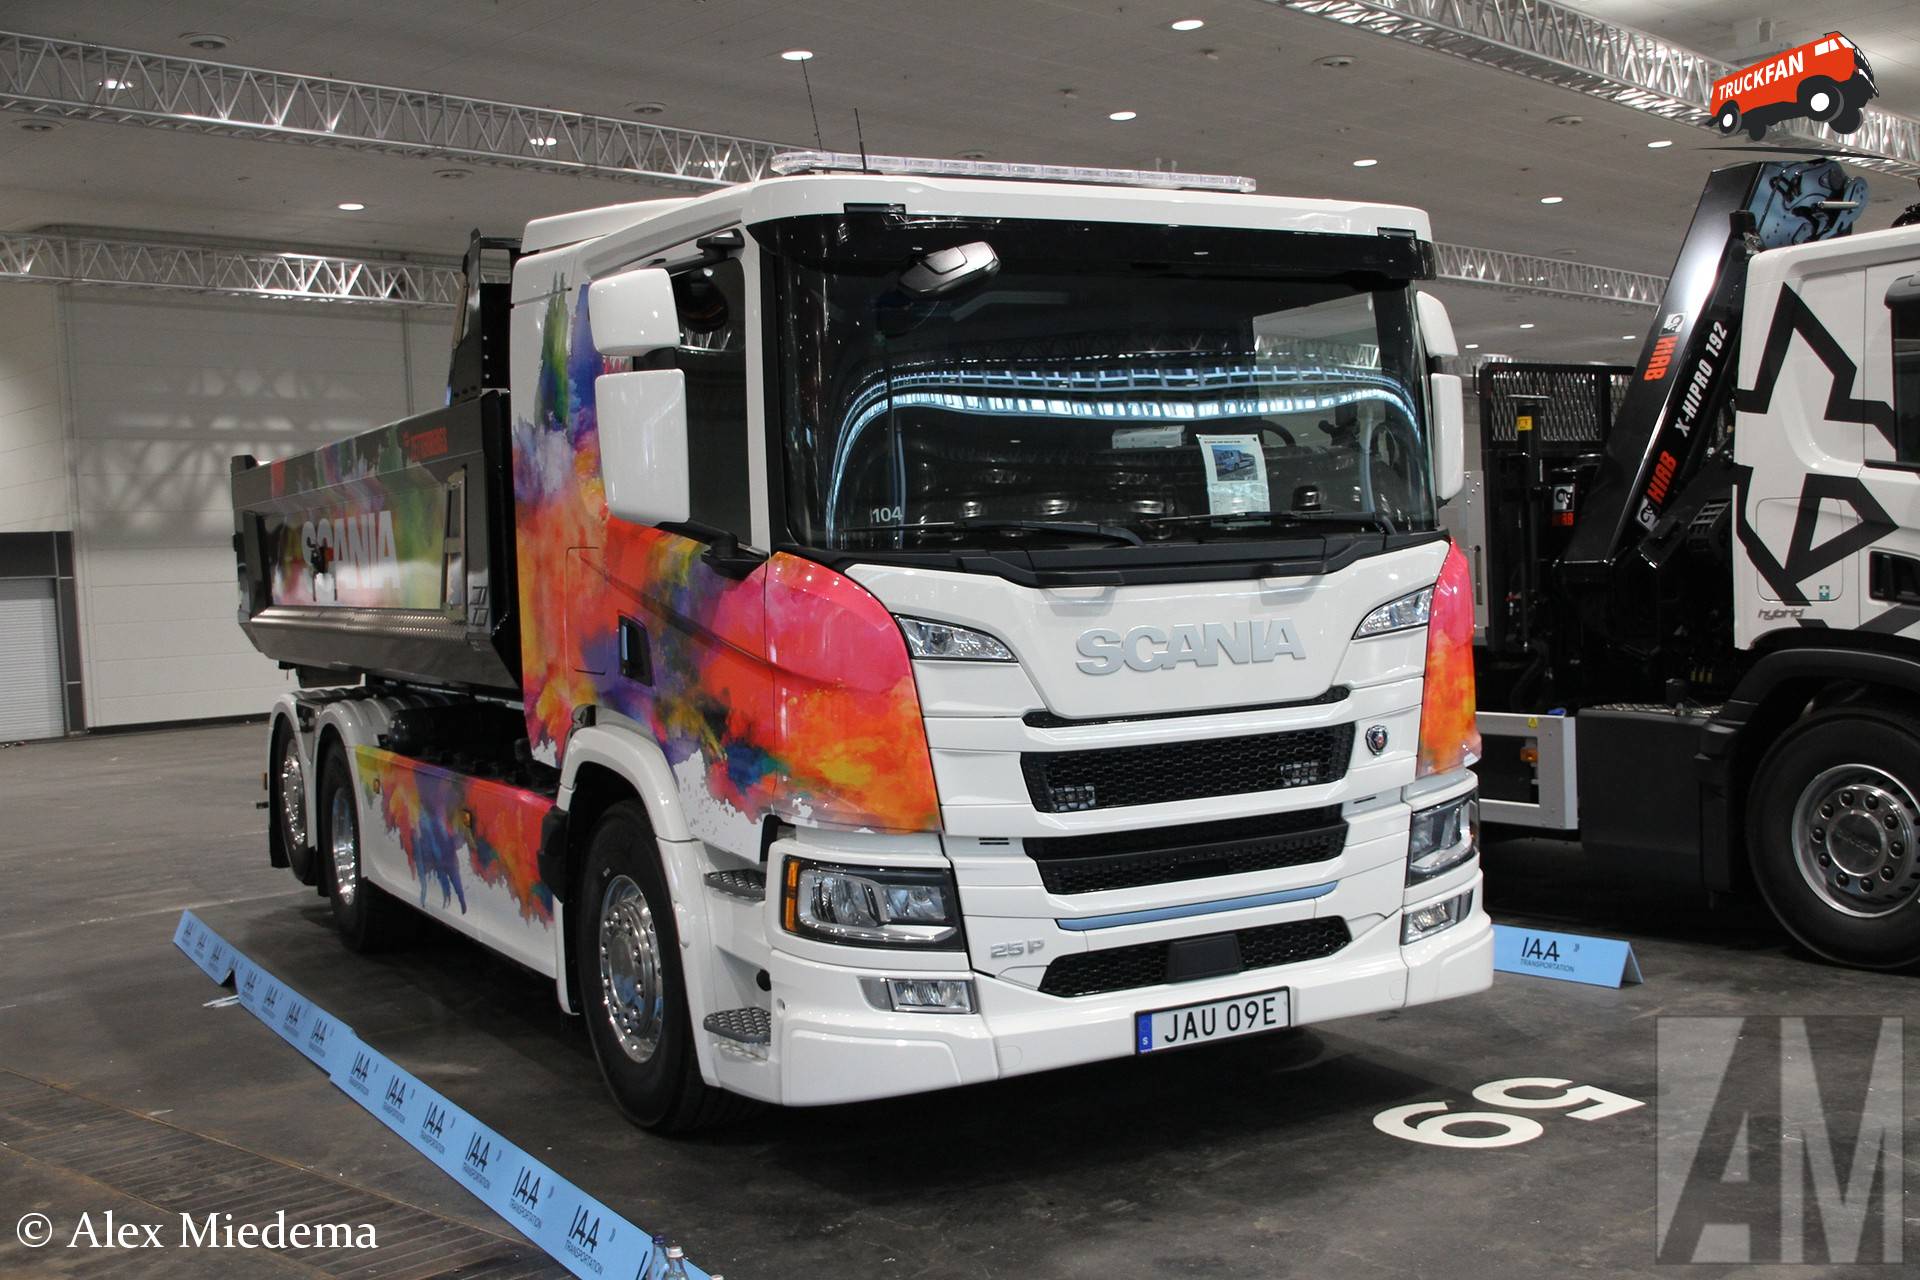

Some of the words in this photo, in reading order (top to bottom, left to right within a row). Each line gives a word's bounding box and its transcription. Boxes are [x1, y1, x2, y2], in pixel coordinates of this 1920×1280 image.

[1643, 335, 1679, 381] HIAB
[1674, 359, 1713, 438] X-HIPRO
[1705, 321, 1728, 357] 192
[1647, 450, 1677, 505] HIAB
[872, 505, 904, 523] 104
[1758, 608, 1805, 621] hybrid
[1075, 616, 1308, 677] SCANIA
[1520, 958, 1575, 973] TRANSPORTATION
[1521, 936, 1560, 962] IAA
[1142, 1036, 1149, 1046] S
[1164, 1007, 1216, 1043] JAU
[1227, 997, 1277, 1032] 09E
[351, 1051, 371, 1083] IAA
[385, 1074, 407, 1110] IAA
[422, 1100, 446, 1139] IAA
[465, 1130, 491, 1173] IAA
[512, 1165, 541, 1210] IAA
[568, 1204, 601, 1254] IAA
